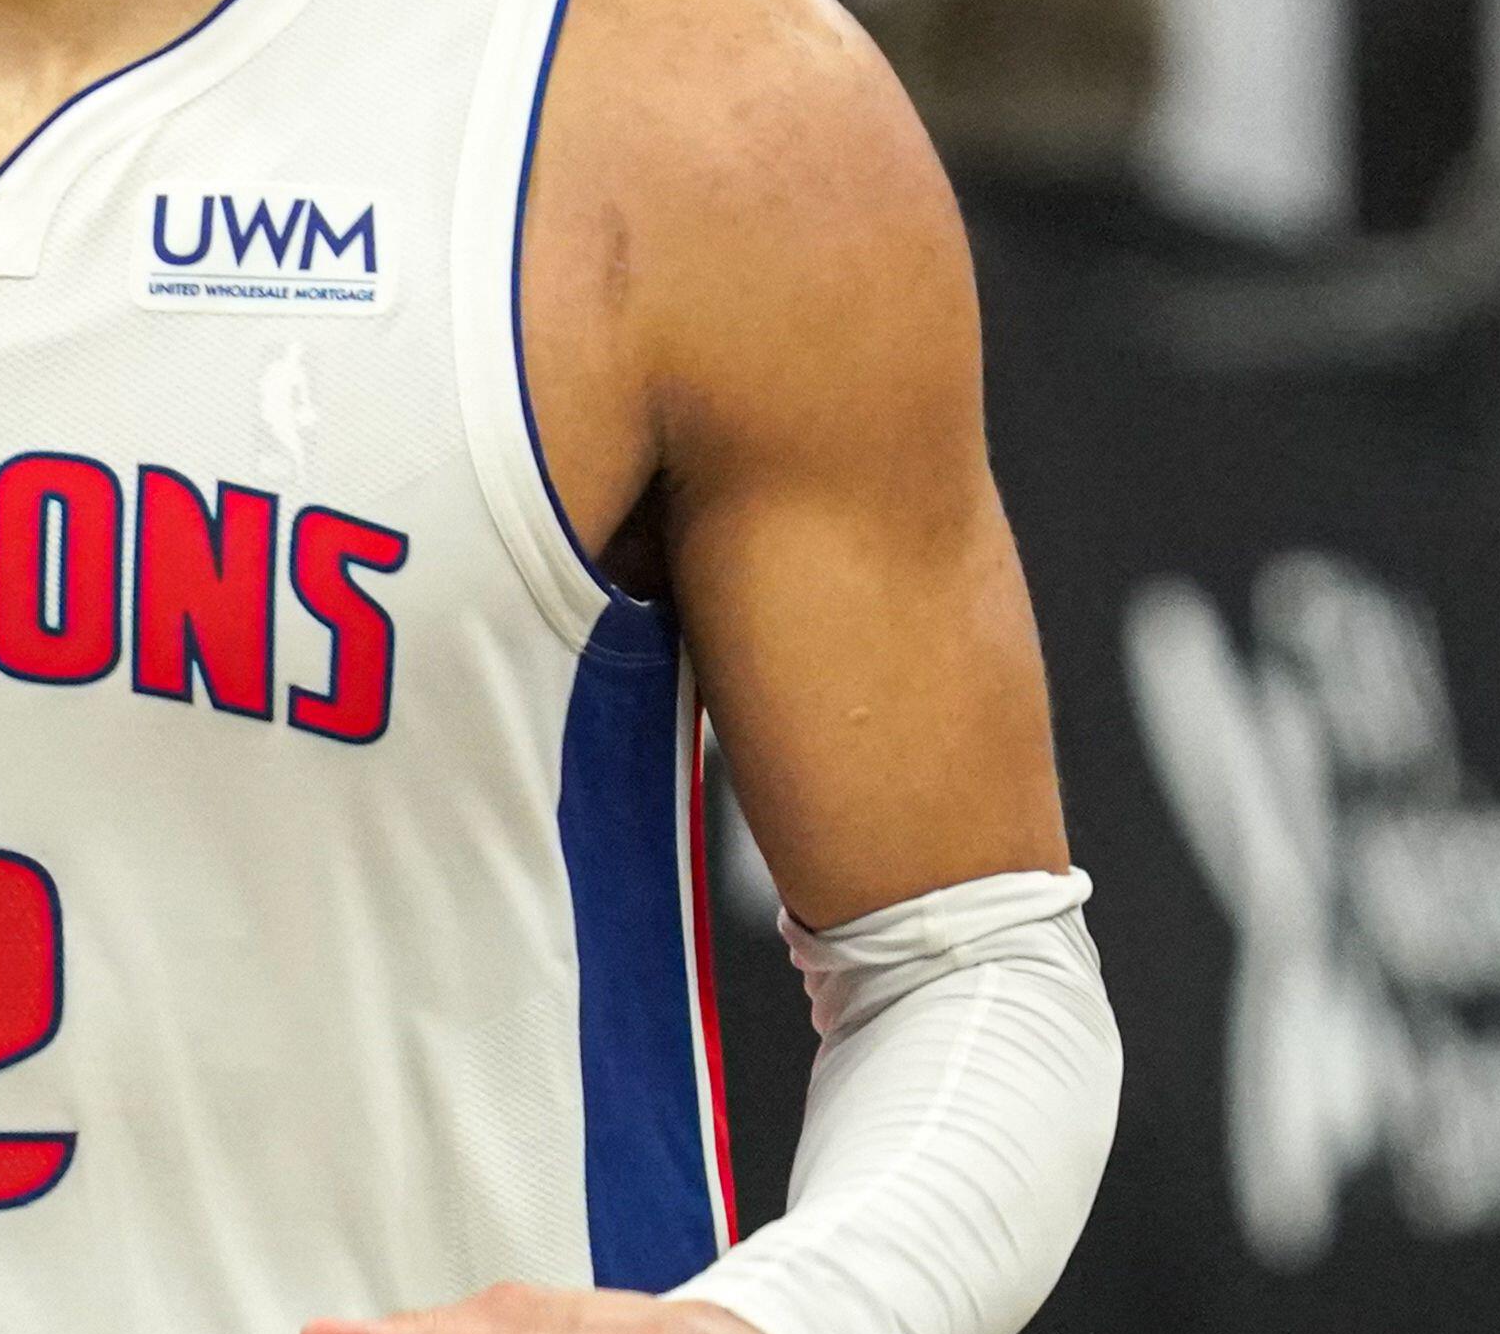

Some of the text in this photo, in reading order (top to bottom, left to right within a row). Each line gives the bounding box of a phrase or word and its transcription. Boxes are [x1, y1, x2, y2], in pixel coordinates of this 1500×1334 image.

[153, 194, 377, 273] UWM
[150, 283, 376, 302] UNITED WHOLESALE MORTGAGE
